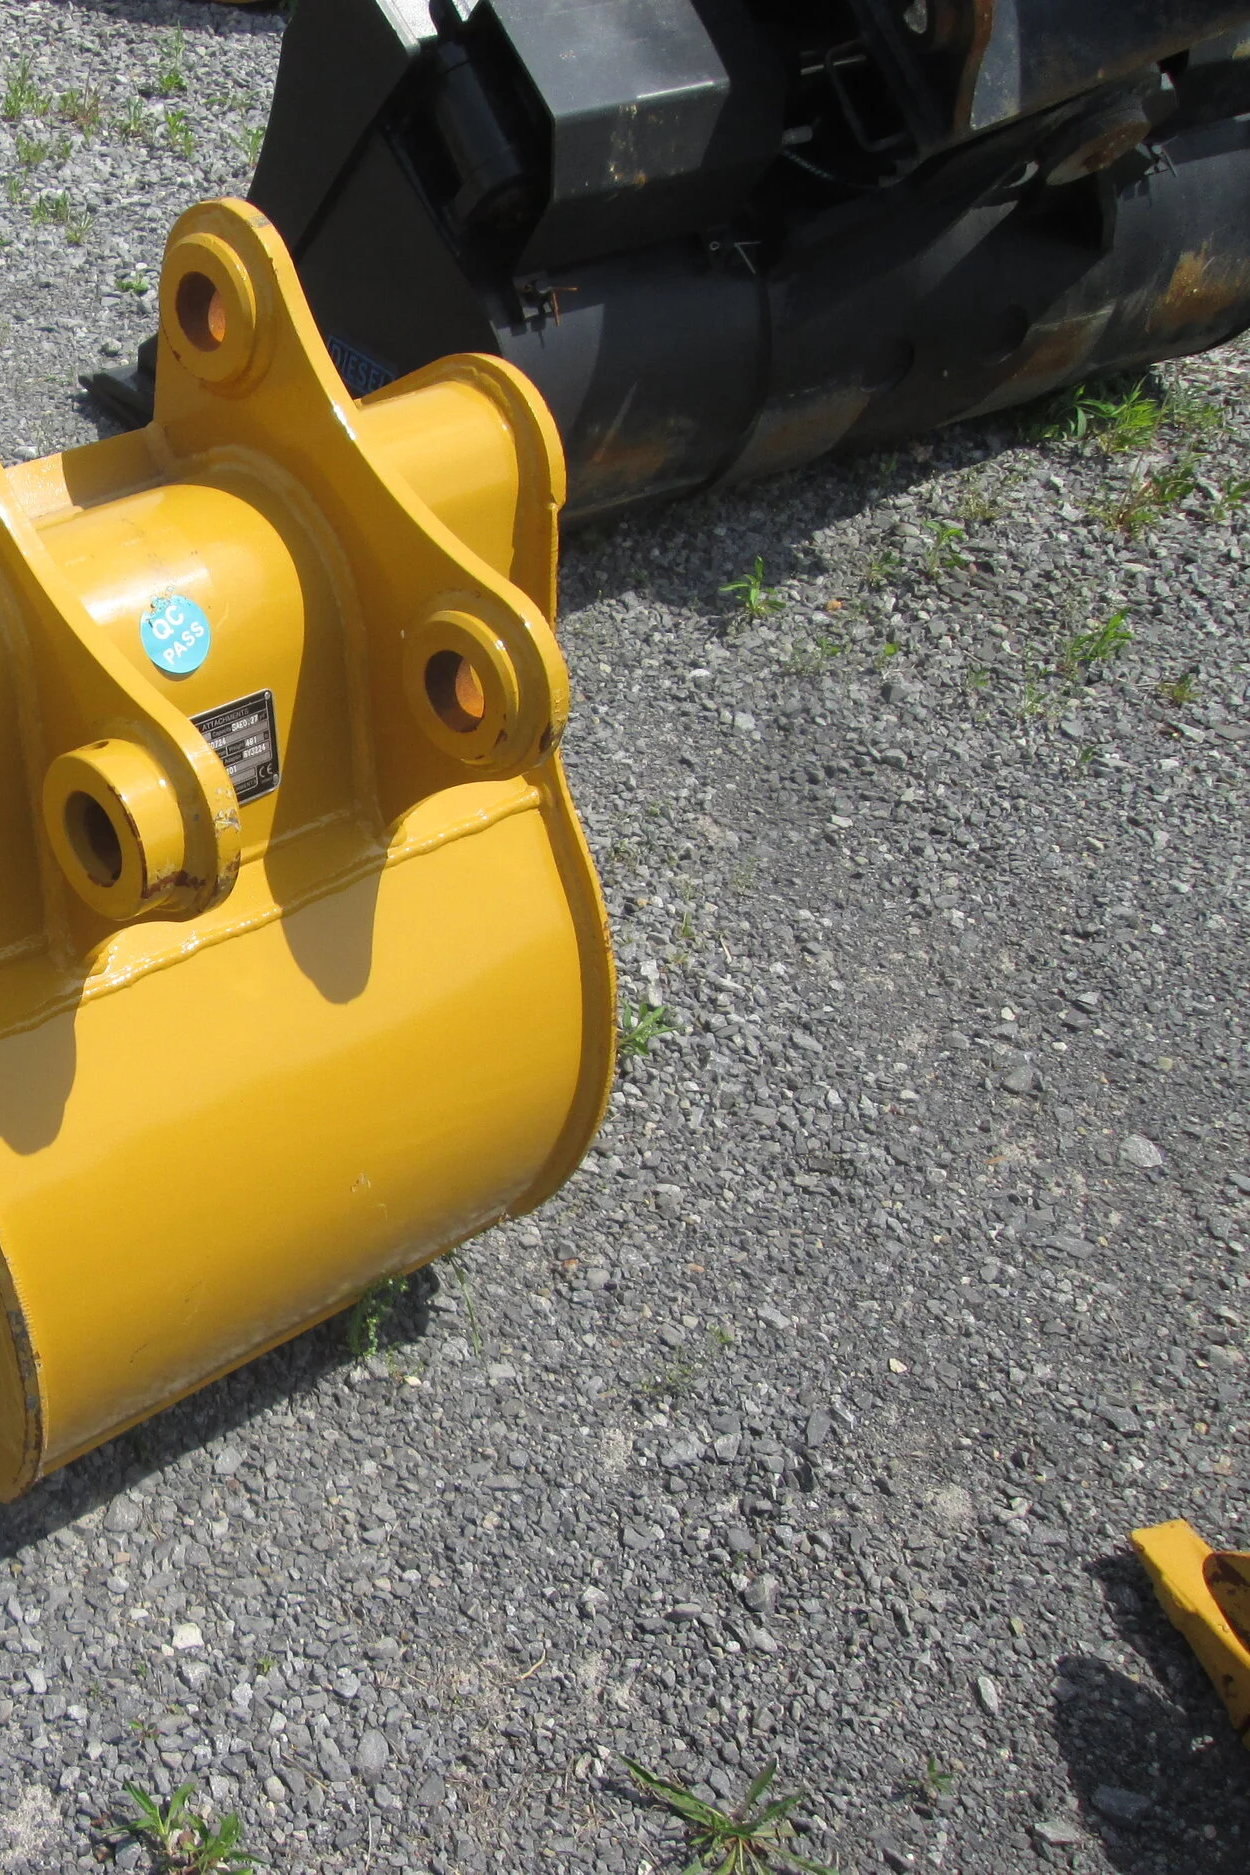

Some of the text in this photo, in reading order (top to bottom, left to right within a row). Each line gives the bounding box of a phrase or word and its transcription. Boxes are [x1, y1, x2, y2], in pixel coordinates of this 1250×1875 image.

[152, 604, 184, 640] QC
[163, 621, 205, 665] PASS
[202, 707, 250, 732] ATTACHMENTS
